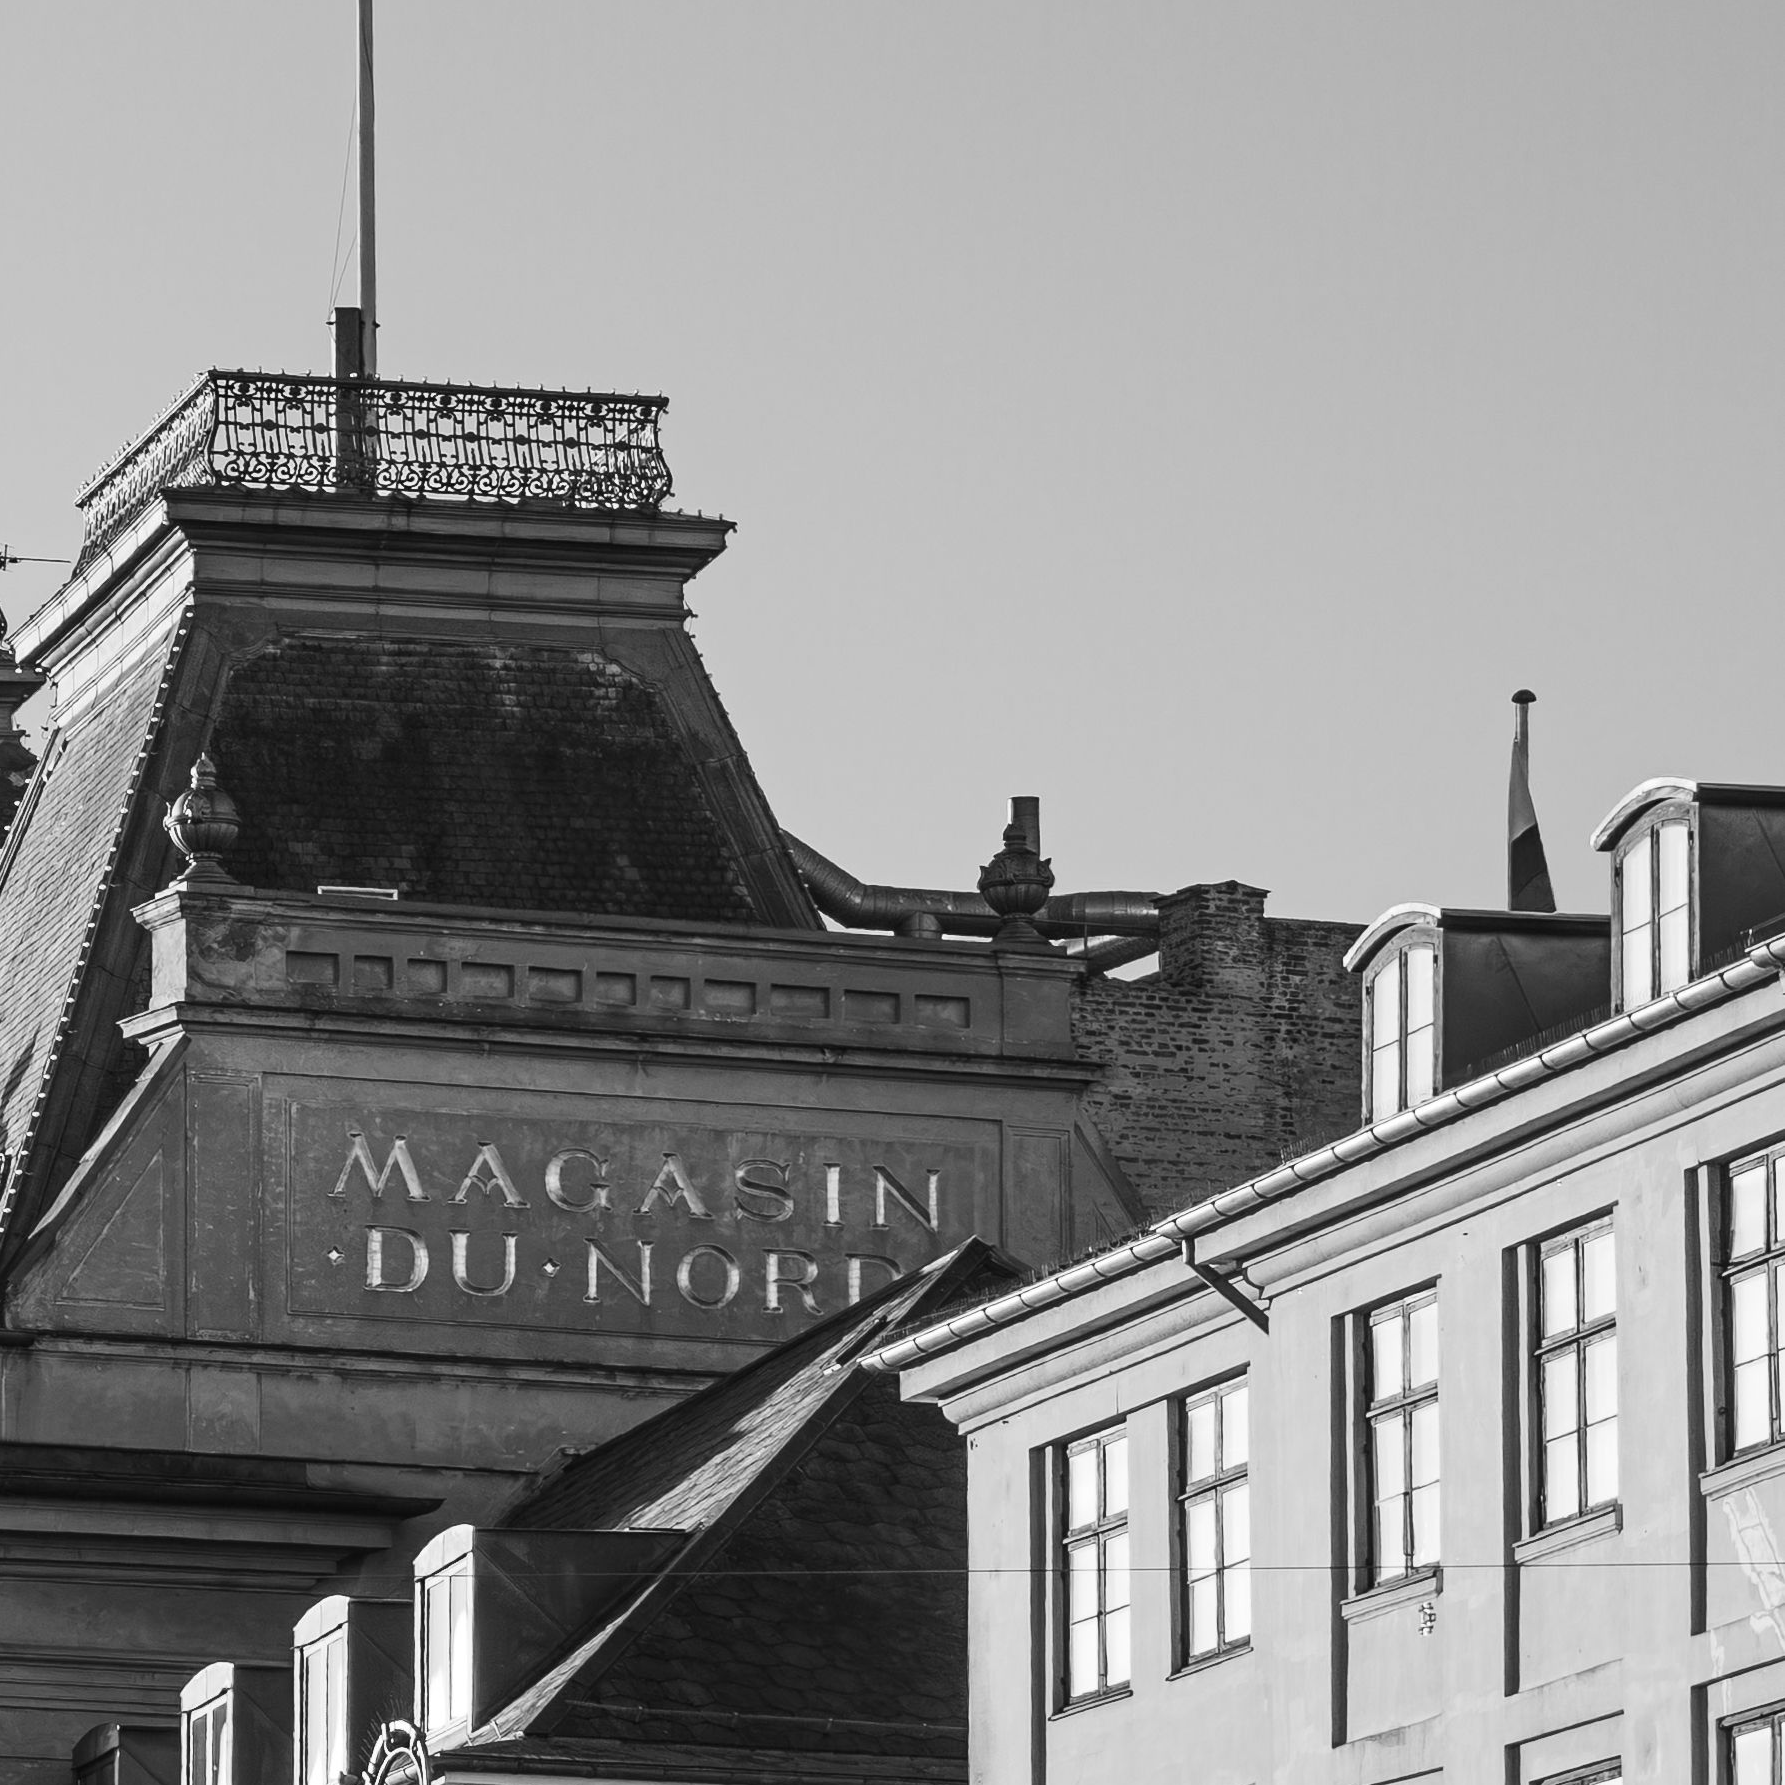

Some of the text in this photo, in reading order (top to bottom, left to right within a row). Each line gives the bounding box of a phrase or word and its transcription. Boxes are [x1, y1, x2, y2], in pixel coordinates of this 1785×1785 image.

[327, 1130, 941, 1234] MAGASIN
[364, 1224, 905, 1316] DU NORD
